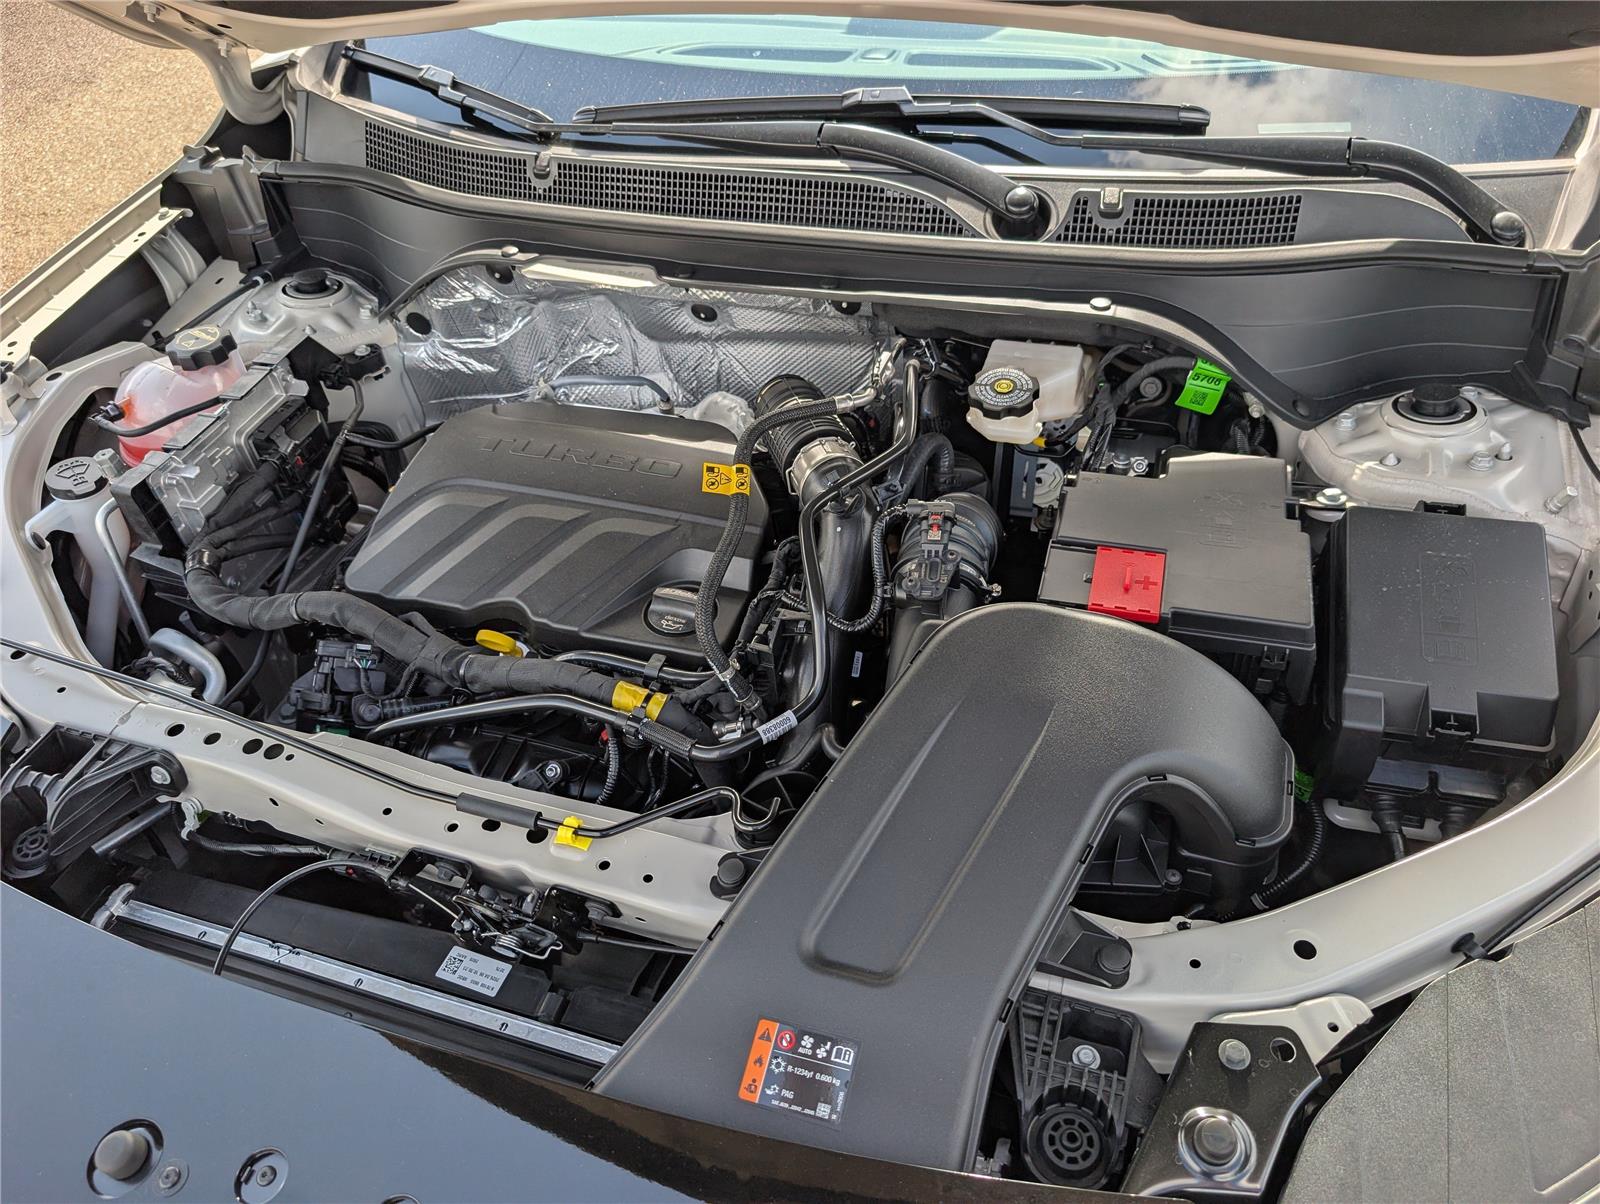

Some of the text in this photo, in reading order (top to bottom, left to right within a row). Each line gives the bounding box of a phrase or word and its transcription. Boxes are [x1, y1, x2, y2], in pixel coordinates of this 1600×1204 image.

[478, 436, 684, 478] TURBO
[798, 1047, 813, 1056] AUTO
[786, 1065, 814, 1078] R-1234yf
[832, 1077, 841, 1087] kg
[780, 1088, 795, 1099] PAG
